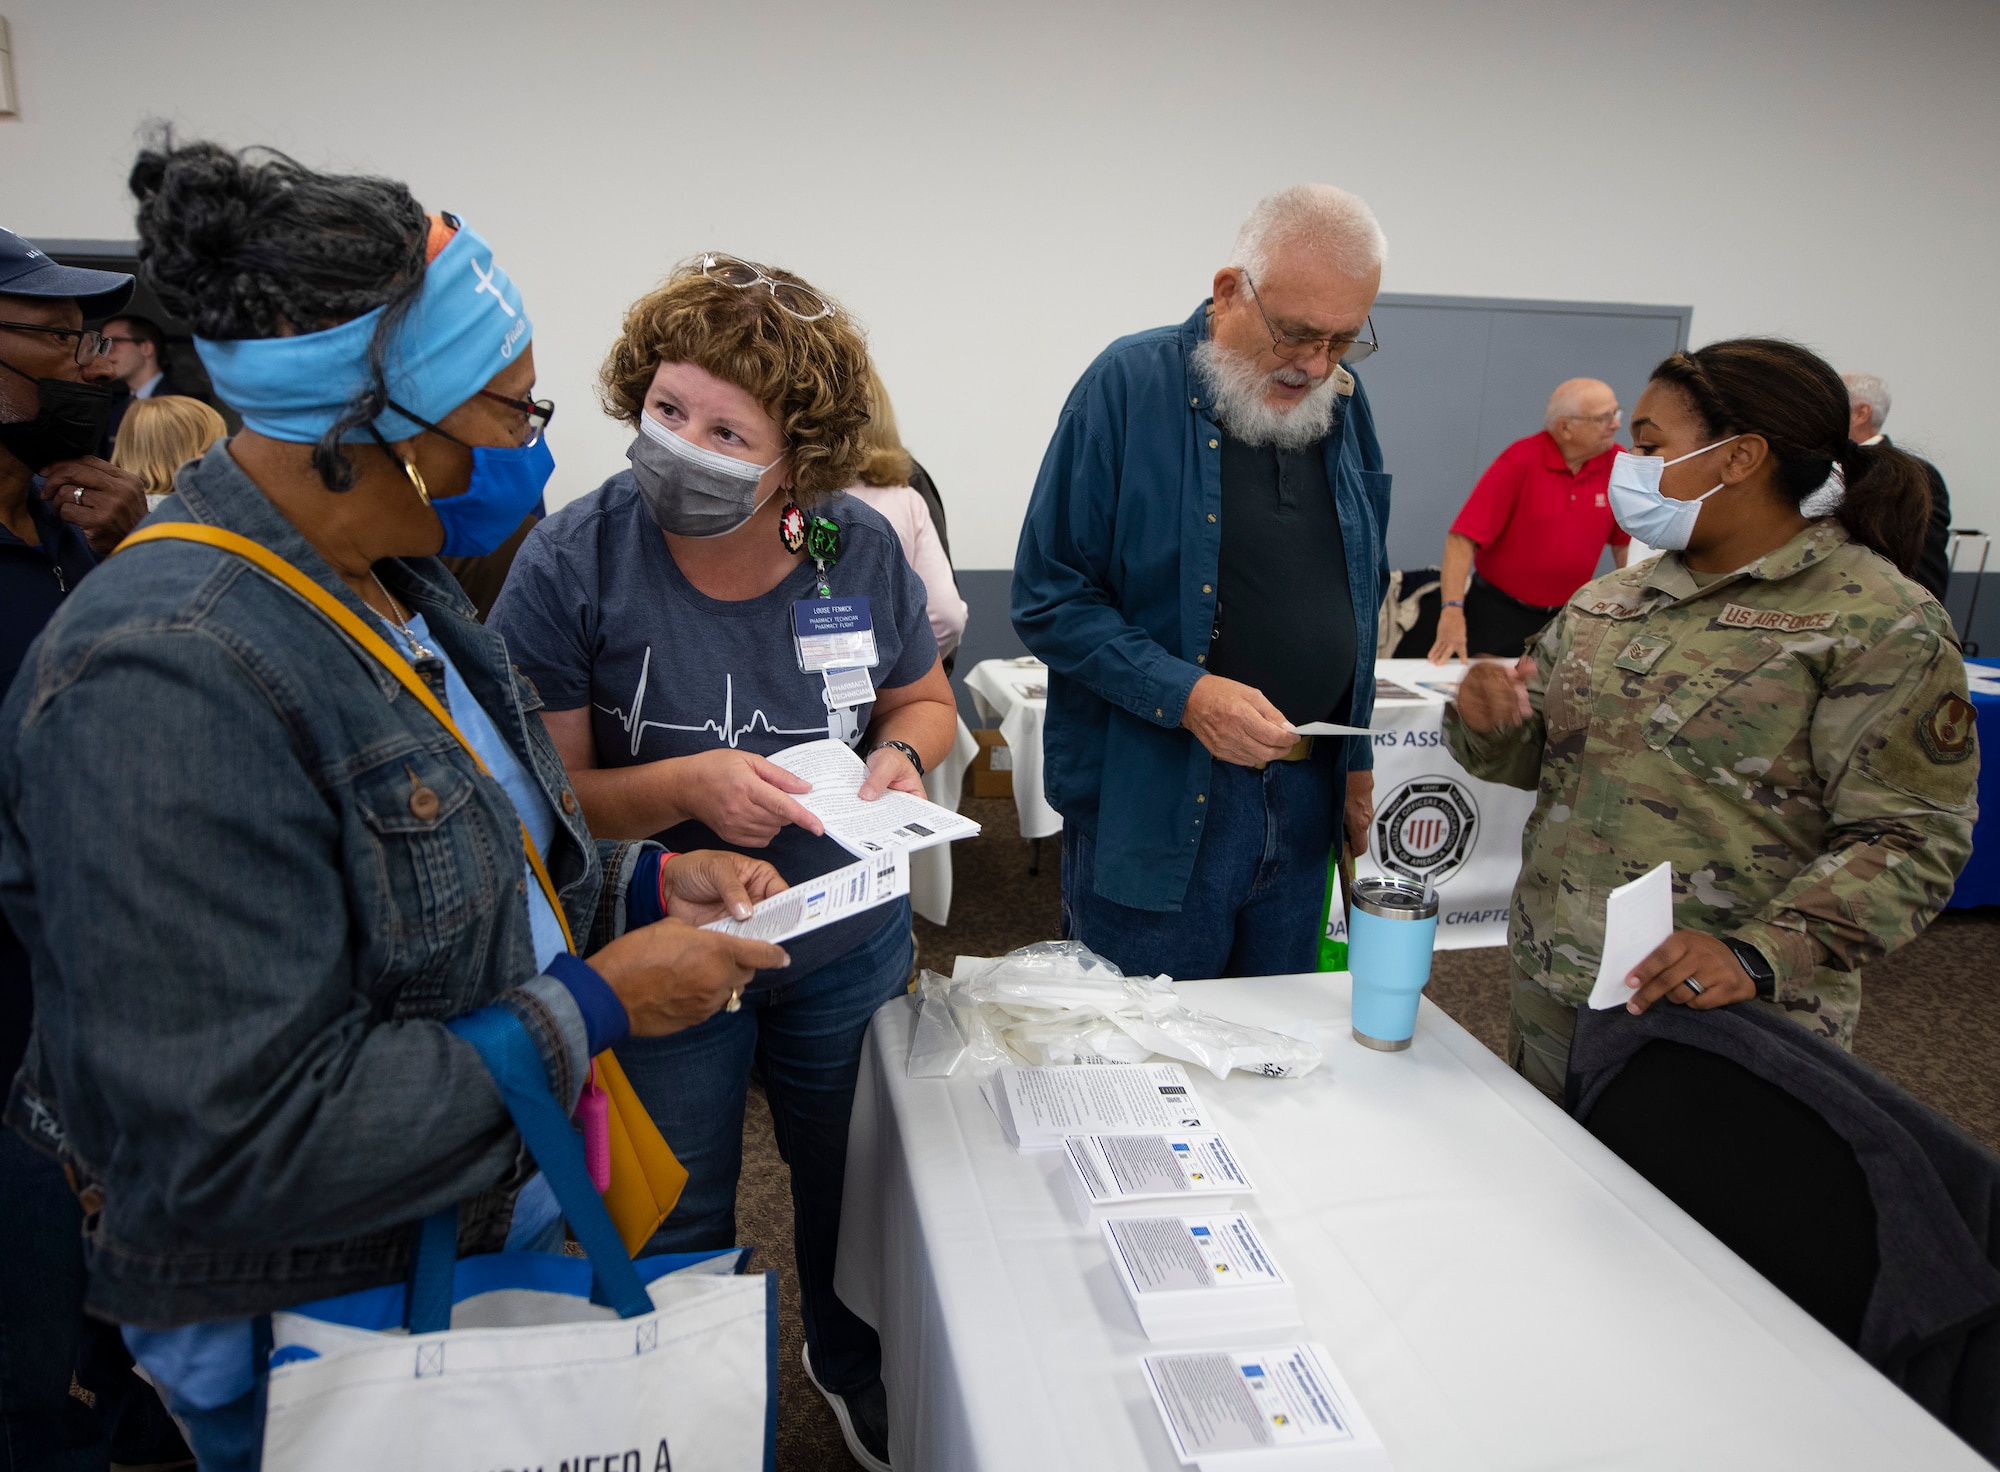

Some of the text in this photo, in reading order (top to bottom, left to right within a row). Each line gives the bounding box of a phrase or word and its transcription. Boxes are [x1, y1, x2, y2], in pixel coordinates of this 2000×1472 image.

[834, 615, 859, 623] TECHNICIAN
[1751, 612, 1779, 628] AIR
[1779, 613, 1830, 629] FORCE
[831, 680, 867, 692] PHARMACY
[832, 688, 871, 700] TECHNICIAN
[1391, 815, 1404, 853] MILITARY
[1402, 797, 1438, 818] OFFICERS
[1439, 801, 1460, 852] ASSOCIATION
[1399, 850, 1446, 866] OF AMERICA
